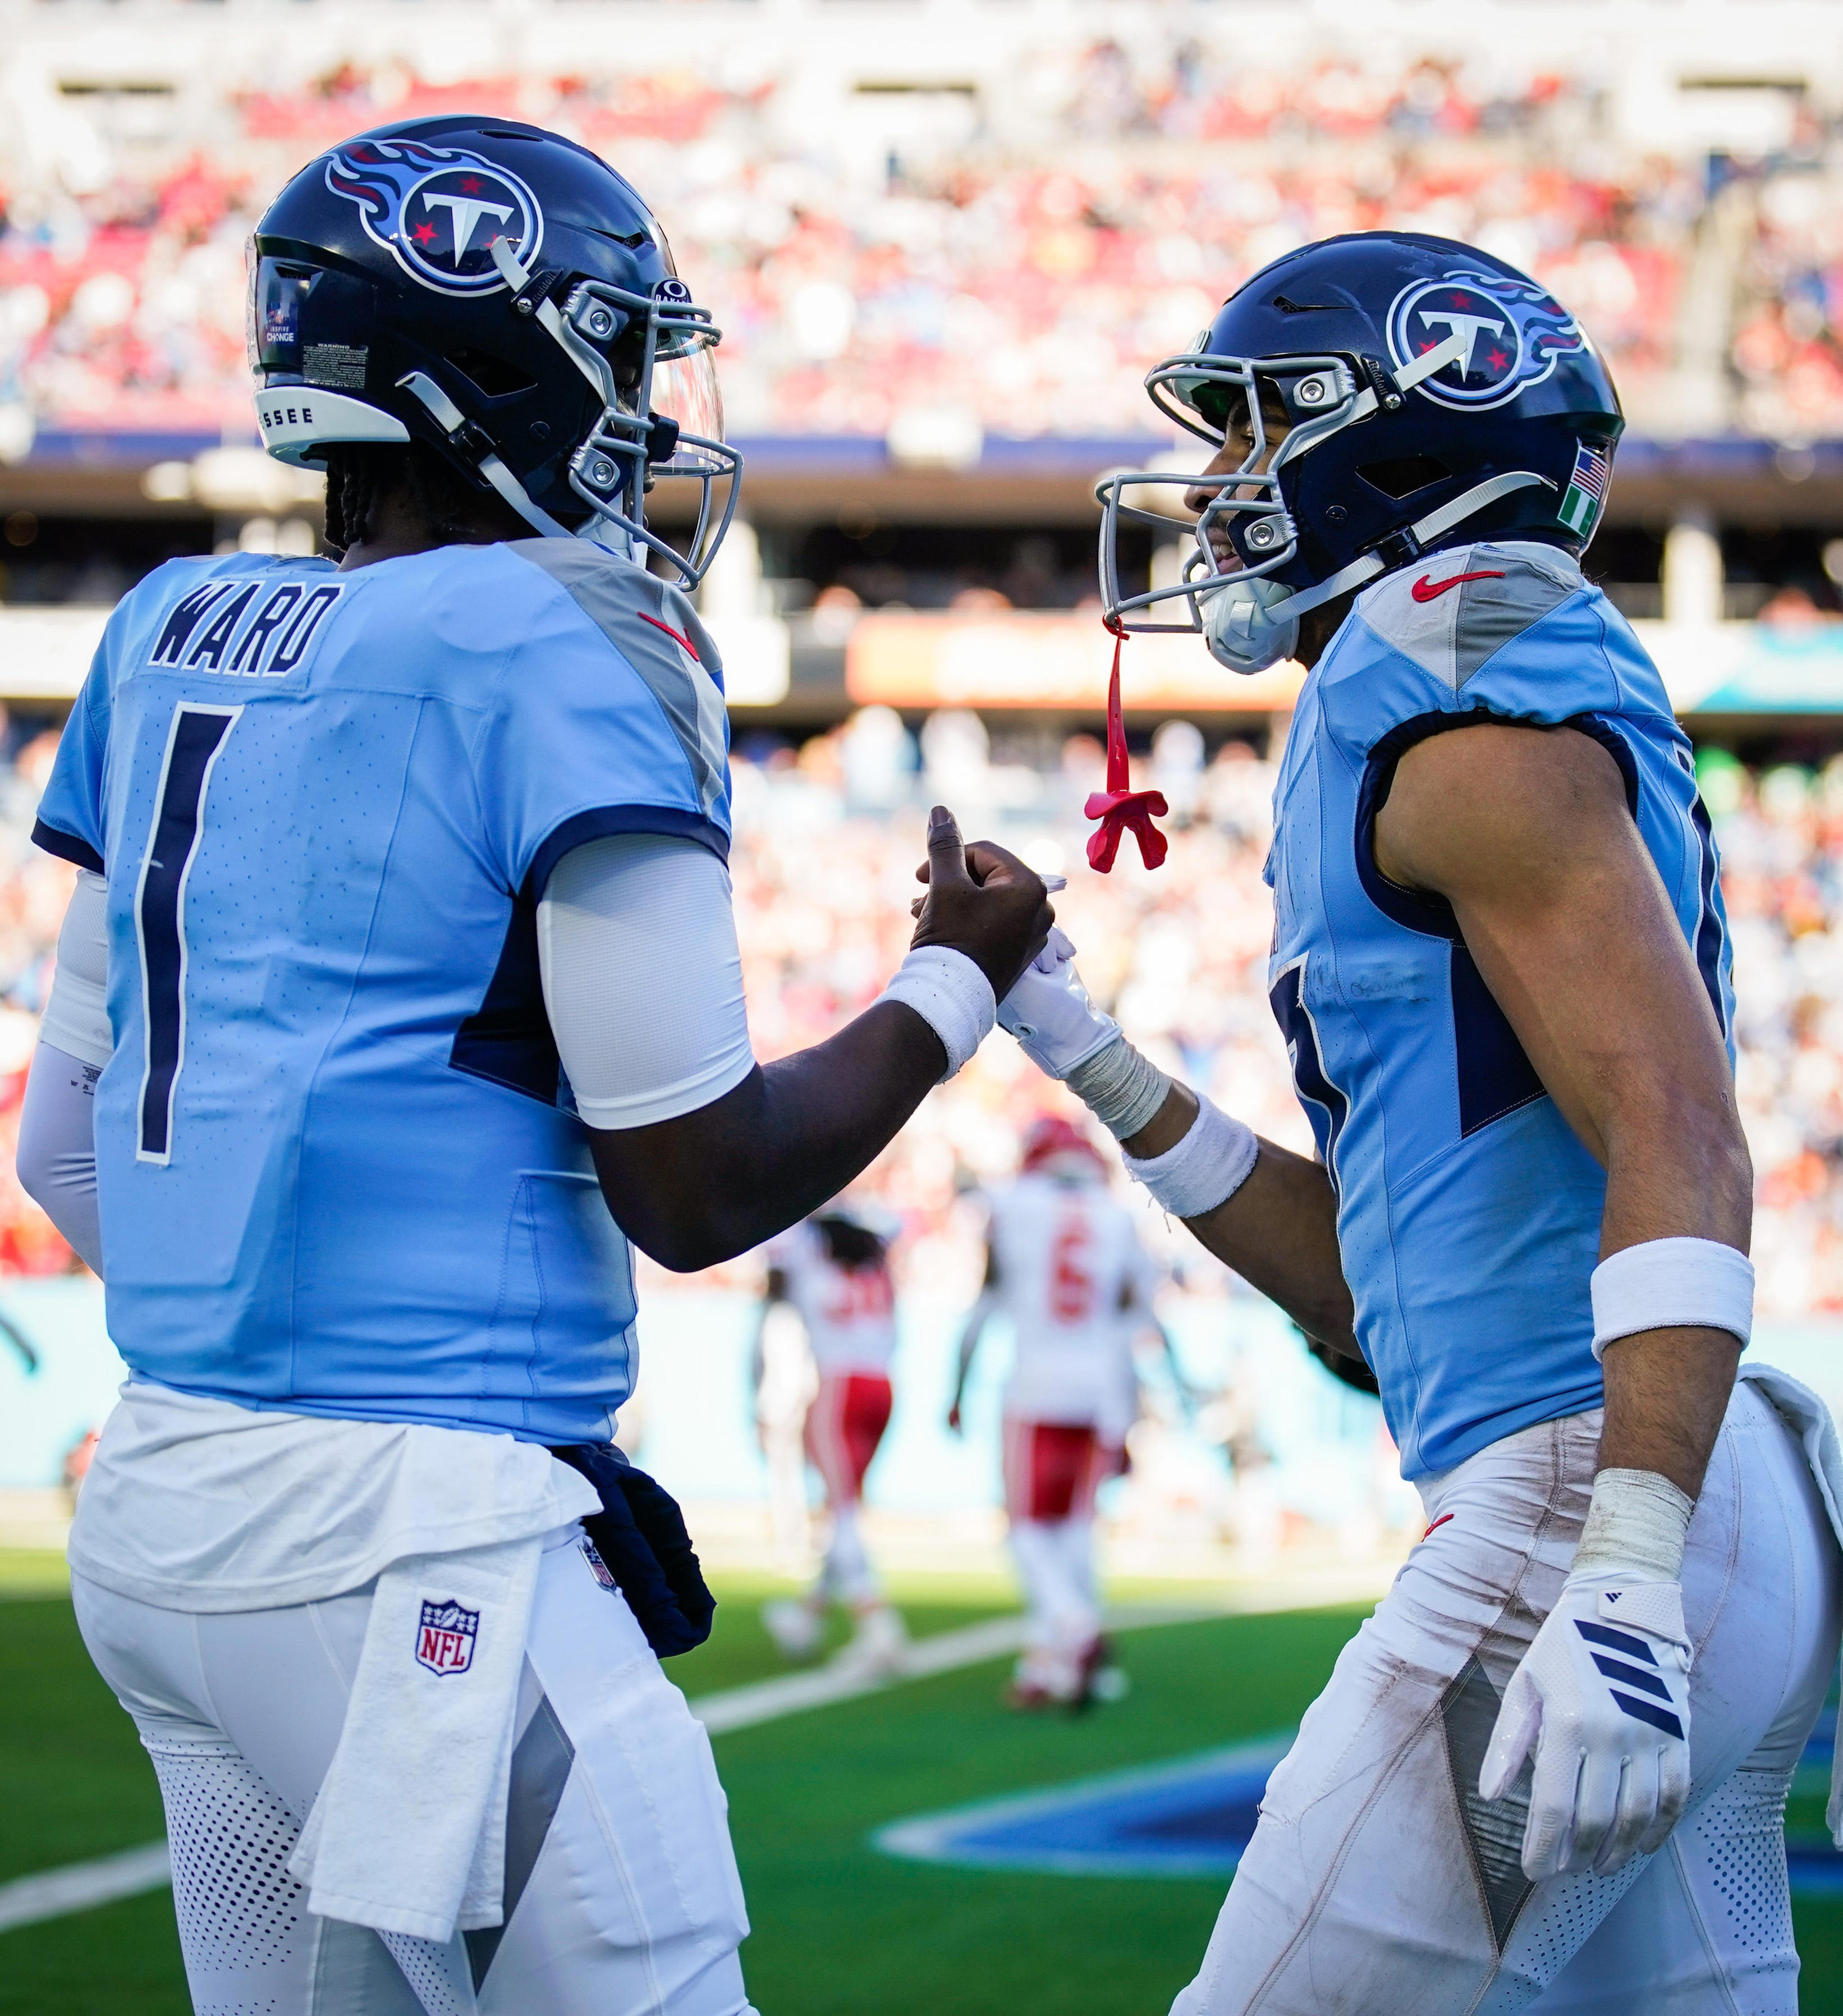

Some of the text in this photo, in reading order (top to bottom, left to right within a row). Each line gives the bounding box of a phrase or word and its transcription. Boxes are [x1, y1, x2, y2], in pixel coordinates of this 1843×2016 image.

[267, 332, 294, 342] CHANGE
[259, 408, 313, 430] SSEE
[147, 580, 346, 677] WARD
[135, 700, 245, 1166] 1
[420, 1628, 465, 1667] NFL
